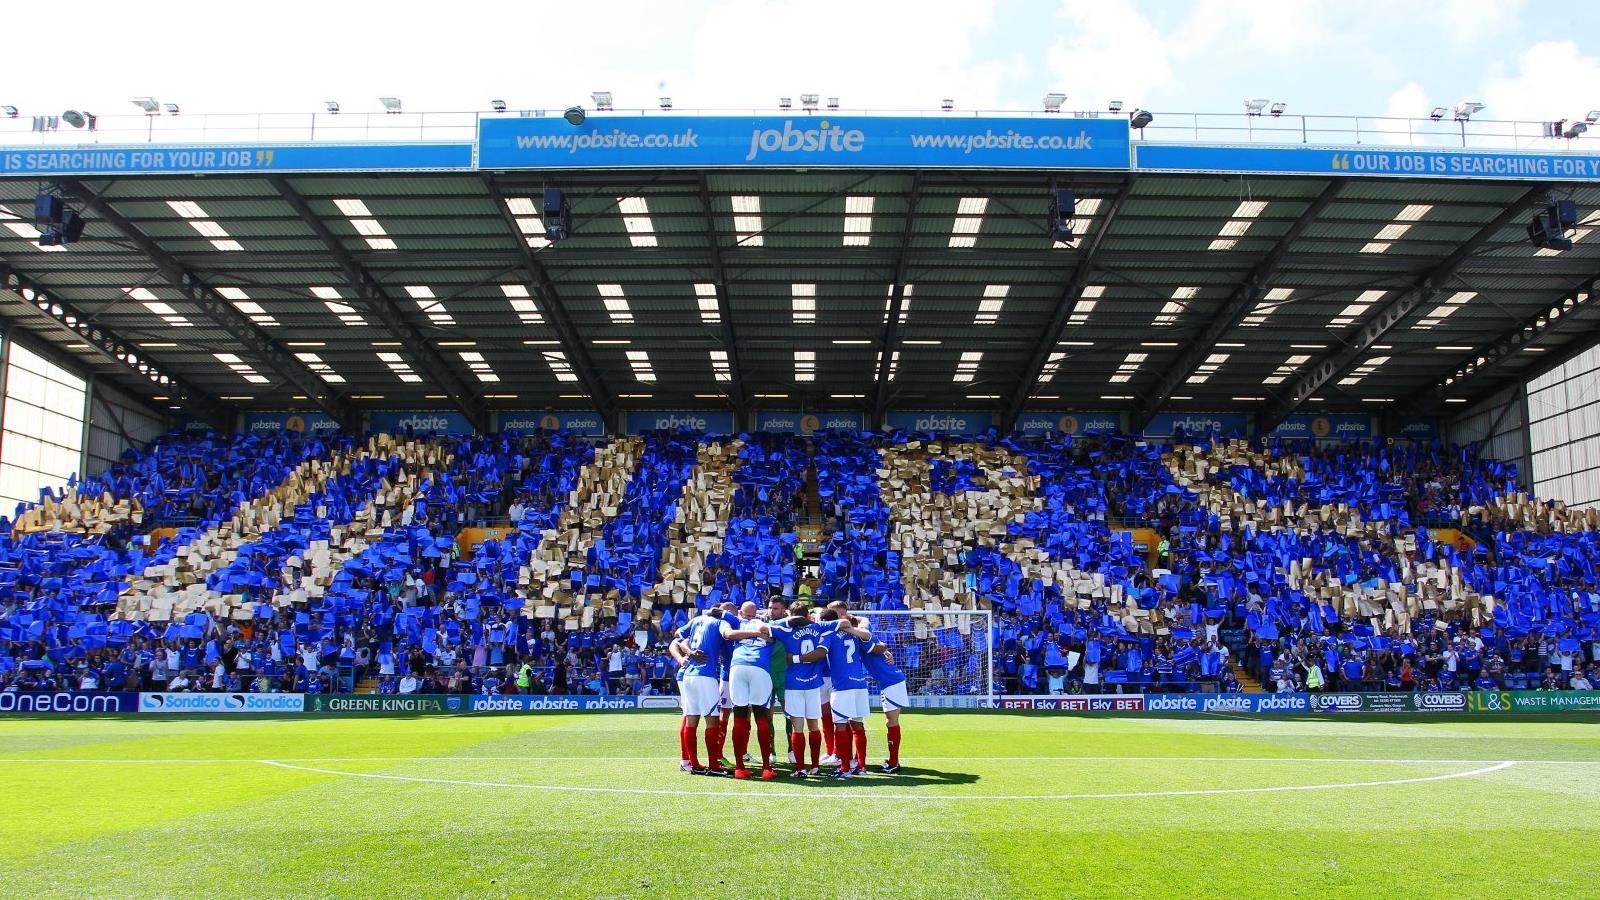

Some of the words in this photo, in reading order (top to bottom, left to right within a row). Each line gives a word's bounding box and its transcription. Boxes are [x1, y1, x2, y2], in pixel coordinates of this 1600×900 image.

[516, 129, 699, 154] www.jobsite.co.uk
[745, 120, 865, 161] jobsite
[911, 129, 1093, 154] www.jobsite.co.uk
[5, 153, 21, 170] IS
[26, 152, 125, 170] SEARCHING
[130, 152, 164, 169] FOR
[168, 151, 216, 168] YOUR
[1393, 155, 1425, 172] JOB
[1430, 156, 1447, 173] IS
[1450, 157, 1549, 174] SEARCHING
[1553, 159, 1586, 176] FOR
[251, 419, 281, 431] jobsite
[504, 419, 534, 431] jobsite
[763, 419, 794, 432] jobsite
[915, 415, 967, 431] jobsite
[1022, 420, 1054, 431] jobsite
[1084, 420, 1115, 432] jobsite
[844, 639, 856, 664] 7
[0, 692, 120, 712] OneCom
[165, 695, 220, 708] Sondico
[247, 695, 302, 708] Sondico
[329, 698, 380, 711] GREENE
[382, 699, 415, 711] KING
[417, 699, 442, 711] IPA
[473, 696, 522, 711] jobsite
[529, 696, 578, 711] jobsite
[585, 697, 634, 709] jobsite
[980, 700, 1000, 709] sy
[1036, 699, 1056, 710] sky
[1061, 700, 1086, 710] BET
[1092, 699, 1112, 711] sky
[1116, 699, 1141, 710] BET
[1149, 694, 1197, 711] jobsite
[1203, 694, 1252, 712] jobsite
[1256, 694, 1306, 712] jobsite
[1320, 695, 1360, 706] COVERS
[1424, 695, 1463, 705] COVERS
[1477, 692, 1512, 711] L&S
[1515, 697, 1547, 706] WASTE
